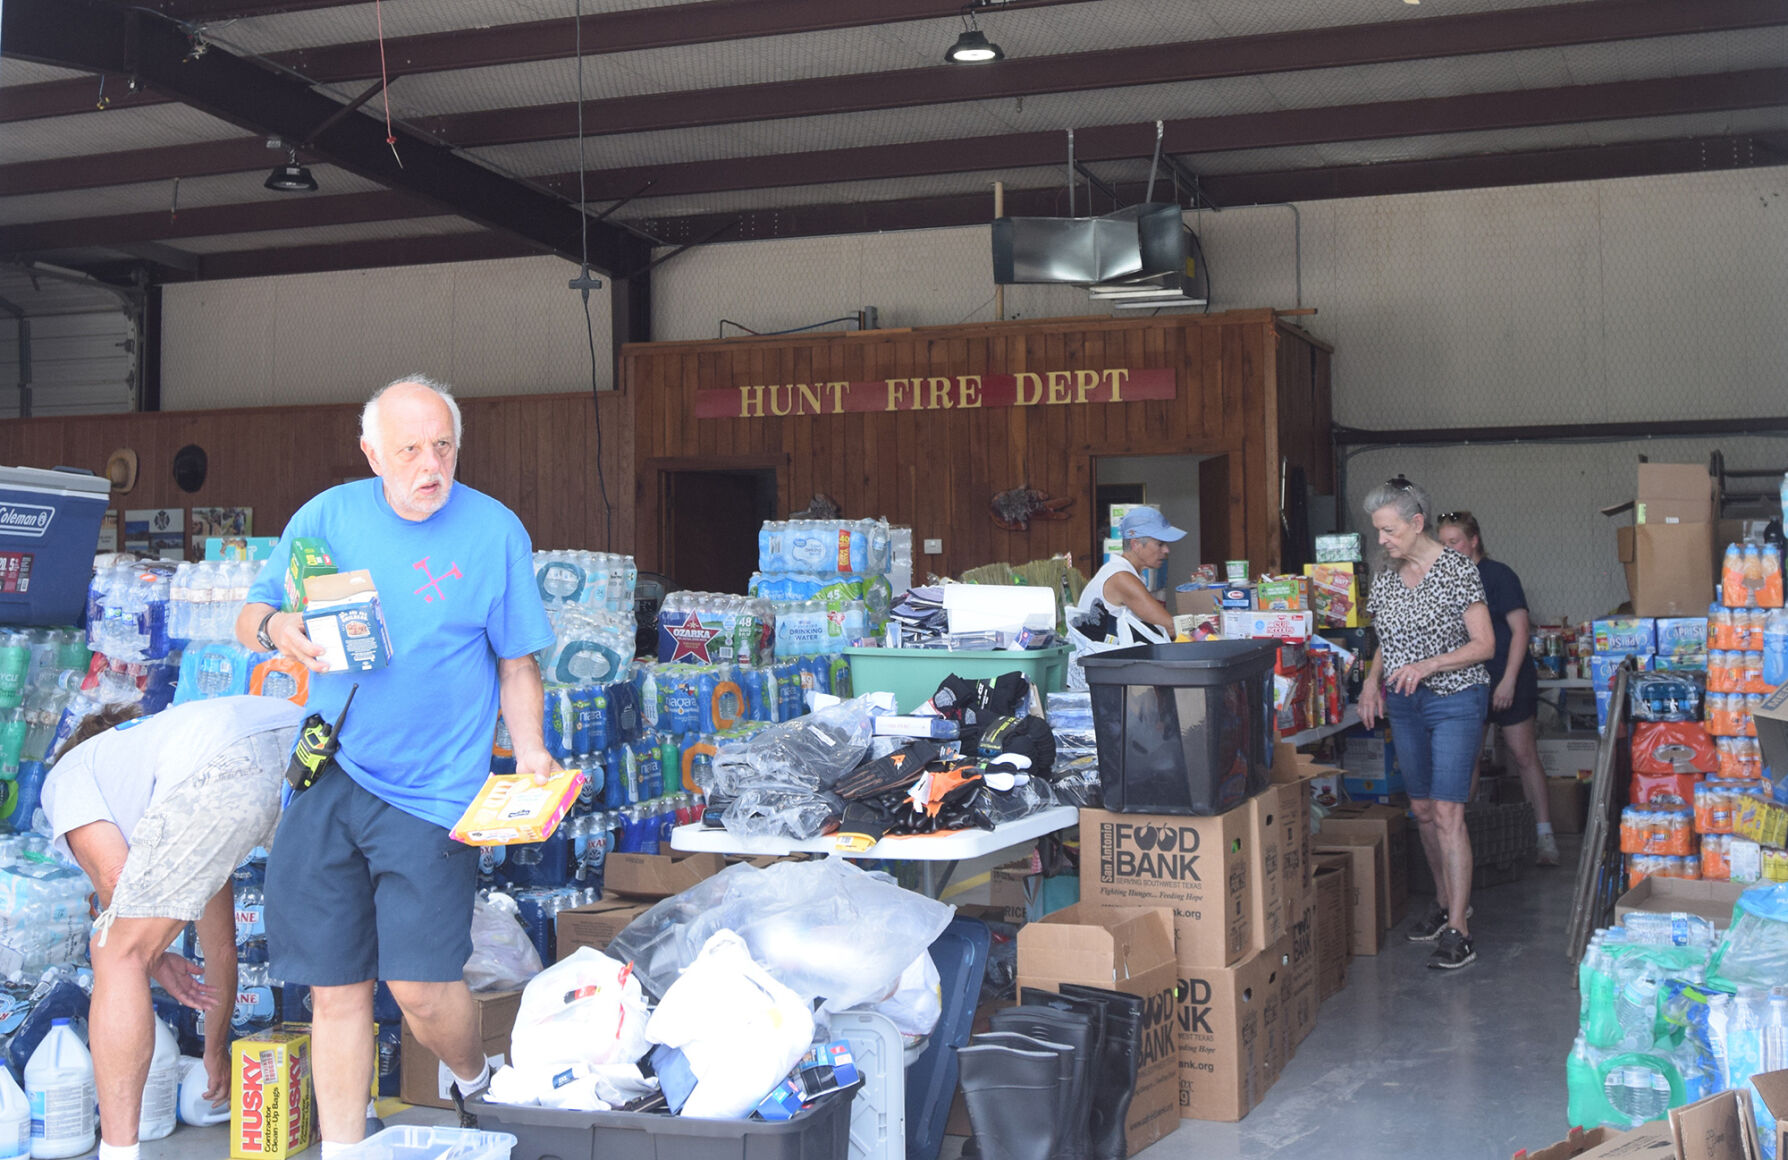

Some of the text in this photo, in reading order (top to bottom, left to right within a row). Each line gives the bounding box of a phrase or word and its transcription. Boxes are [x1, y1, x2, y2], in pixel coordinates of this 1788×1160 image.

[739, 369, 1129, 417] HUNT FIRE DEPT
[827, 590, 840, 600] 45
[673, 628, 711, 639] OZARKA
[739, 616, 752, 627] 48
[789, 627, 823, 636] DRINKING
[1116, 823, 1200, 853] FOOD
[1101, 824, 1113, 882] San Antonio
[1116, 850, 1202, 882] BANK
[1100, 887, 1127, 898] Fighting
[1158, 892, 1185, 902] Feeding
[1184, 893, 1204, 902] Hope
[1116, 877, 1203, 890] SERVING SOUTHWEST TEXAS
[1198, 1045, 1216, 1055] Hope
[241, 1053, 263, 1152] HUSKY
[271, 1086, 280, 1110] Bags
[288, 1054, 301, 1149] HUSKY
[264, 1106, 272, 1153] Contractor
